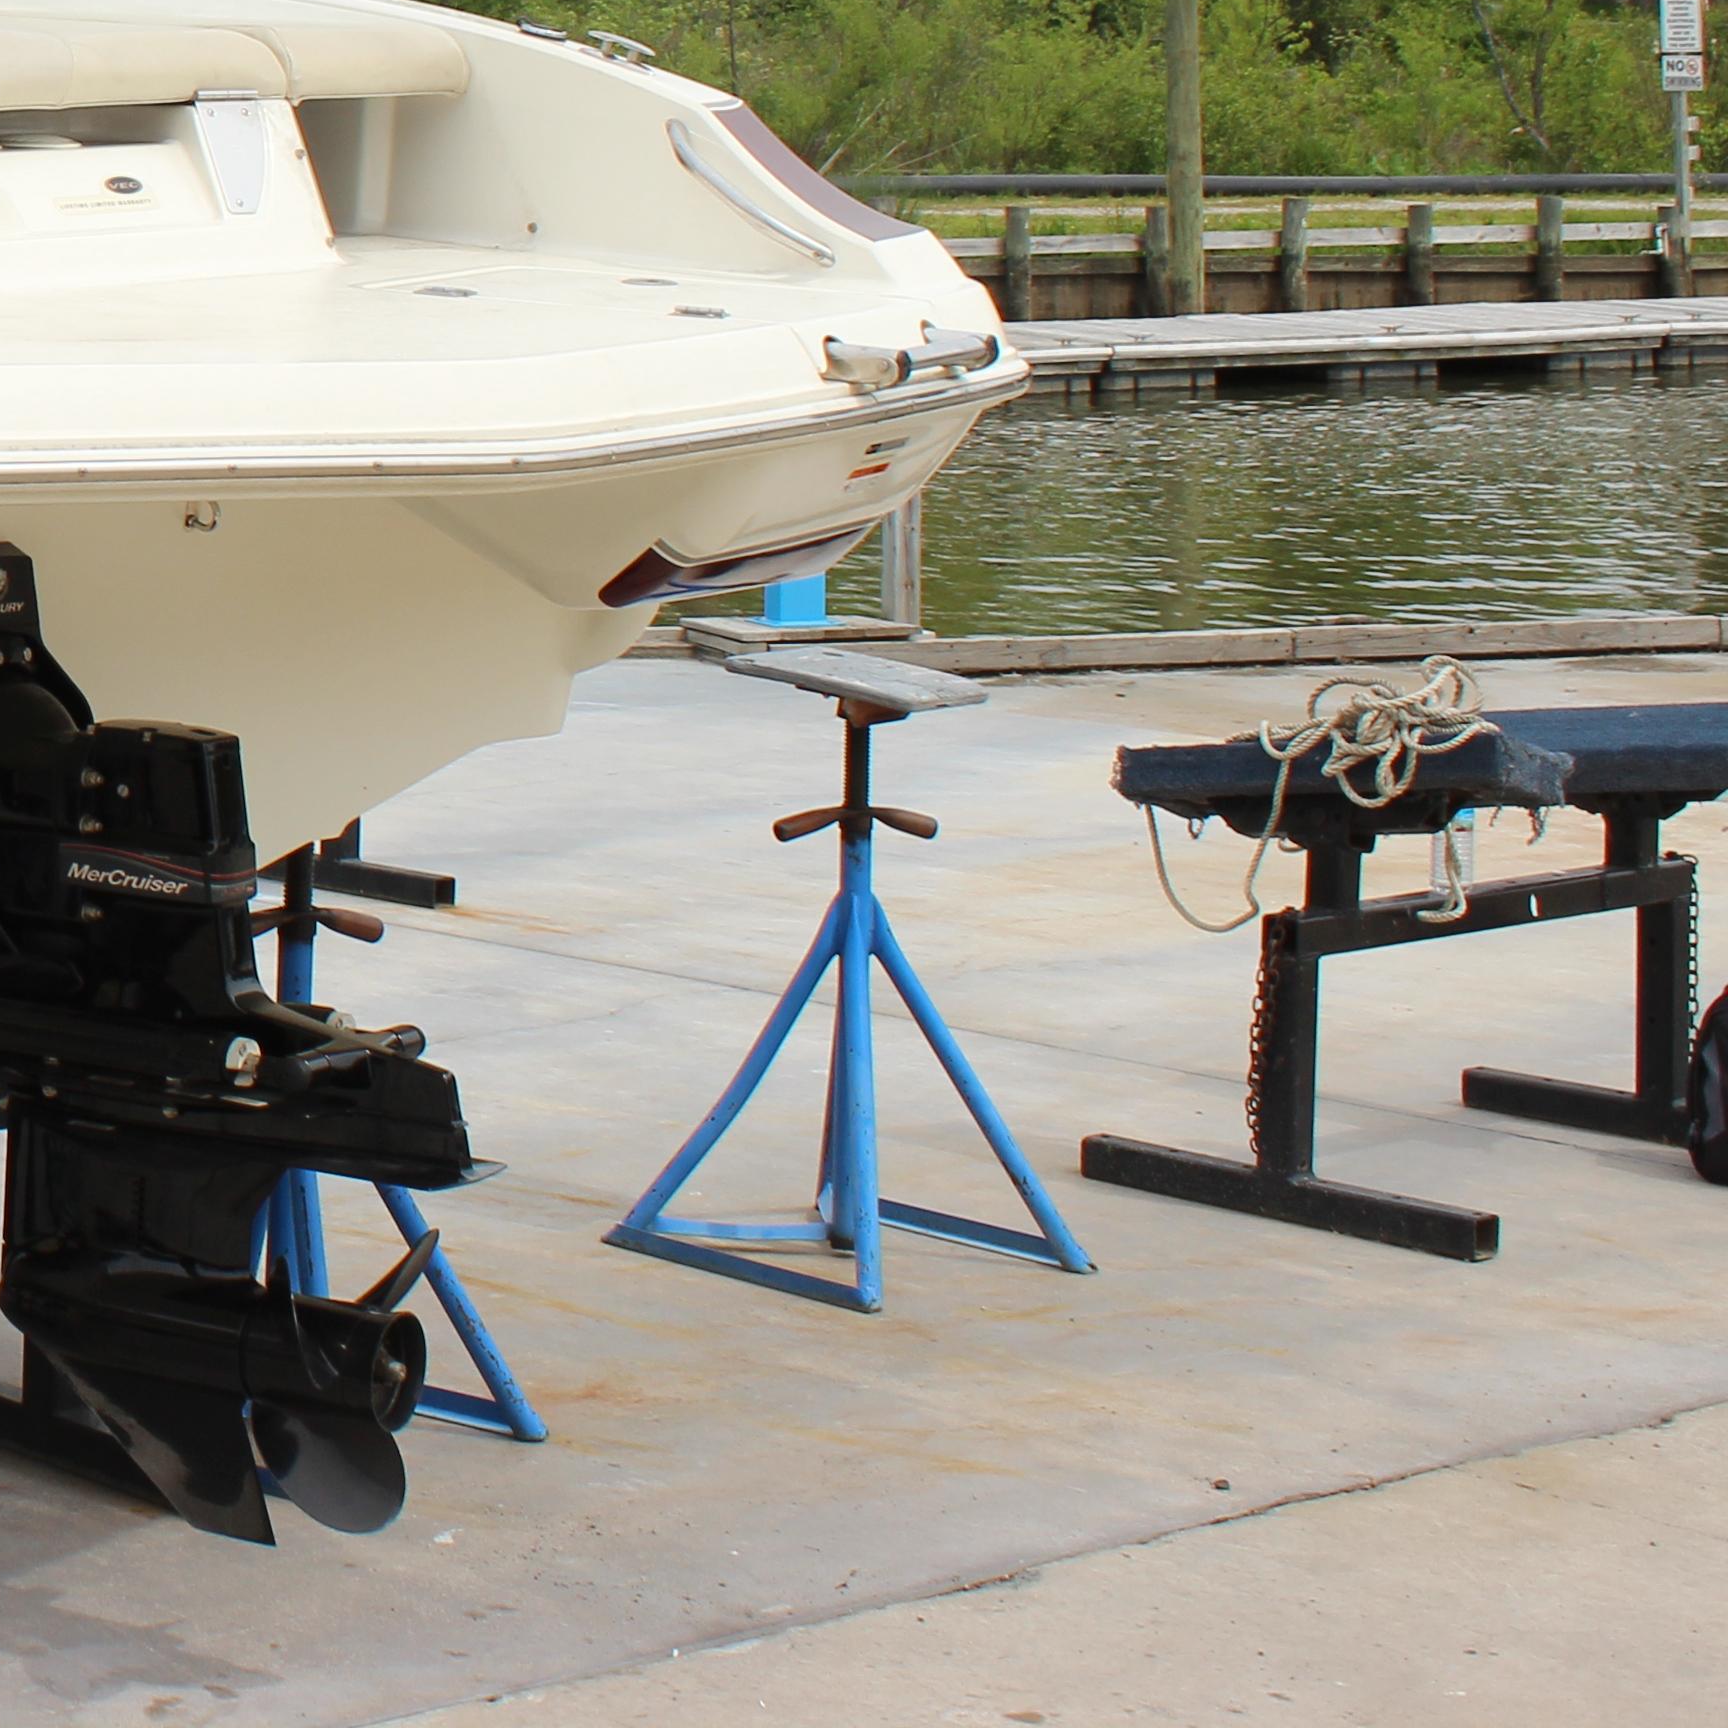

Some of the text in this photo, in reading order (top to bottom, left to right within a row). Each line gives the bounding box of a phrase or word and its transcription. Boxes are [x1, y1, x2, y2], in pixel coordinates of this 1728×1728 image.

[1666, 59, 1685, 72] NO
[107, 180, 139, 190] VEC
[67, 861, 189, 895] MerCruiser
